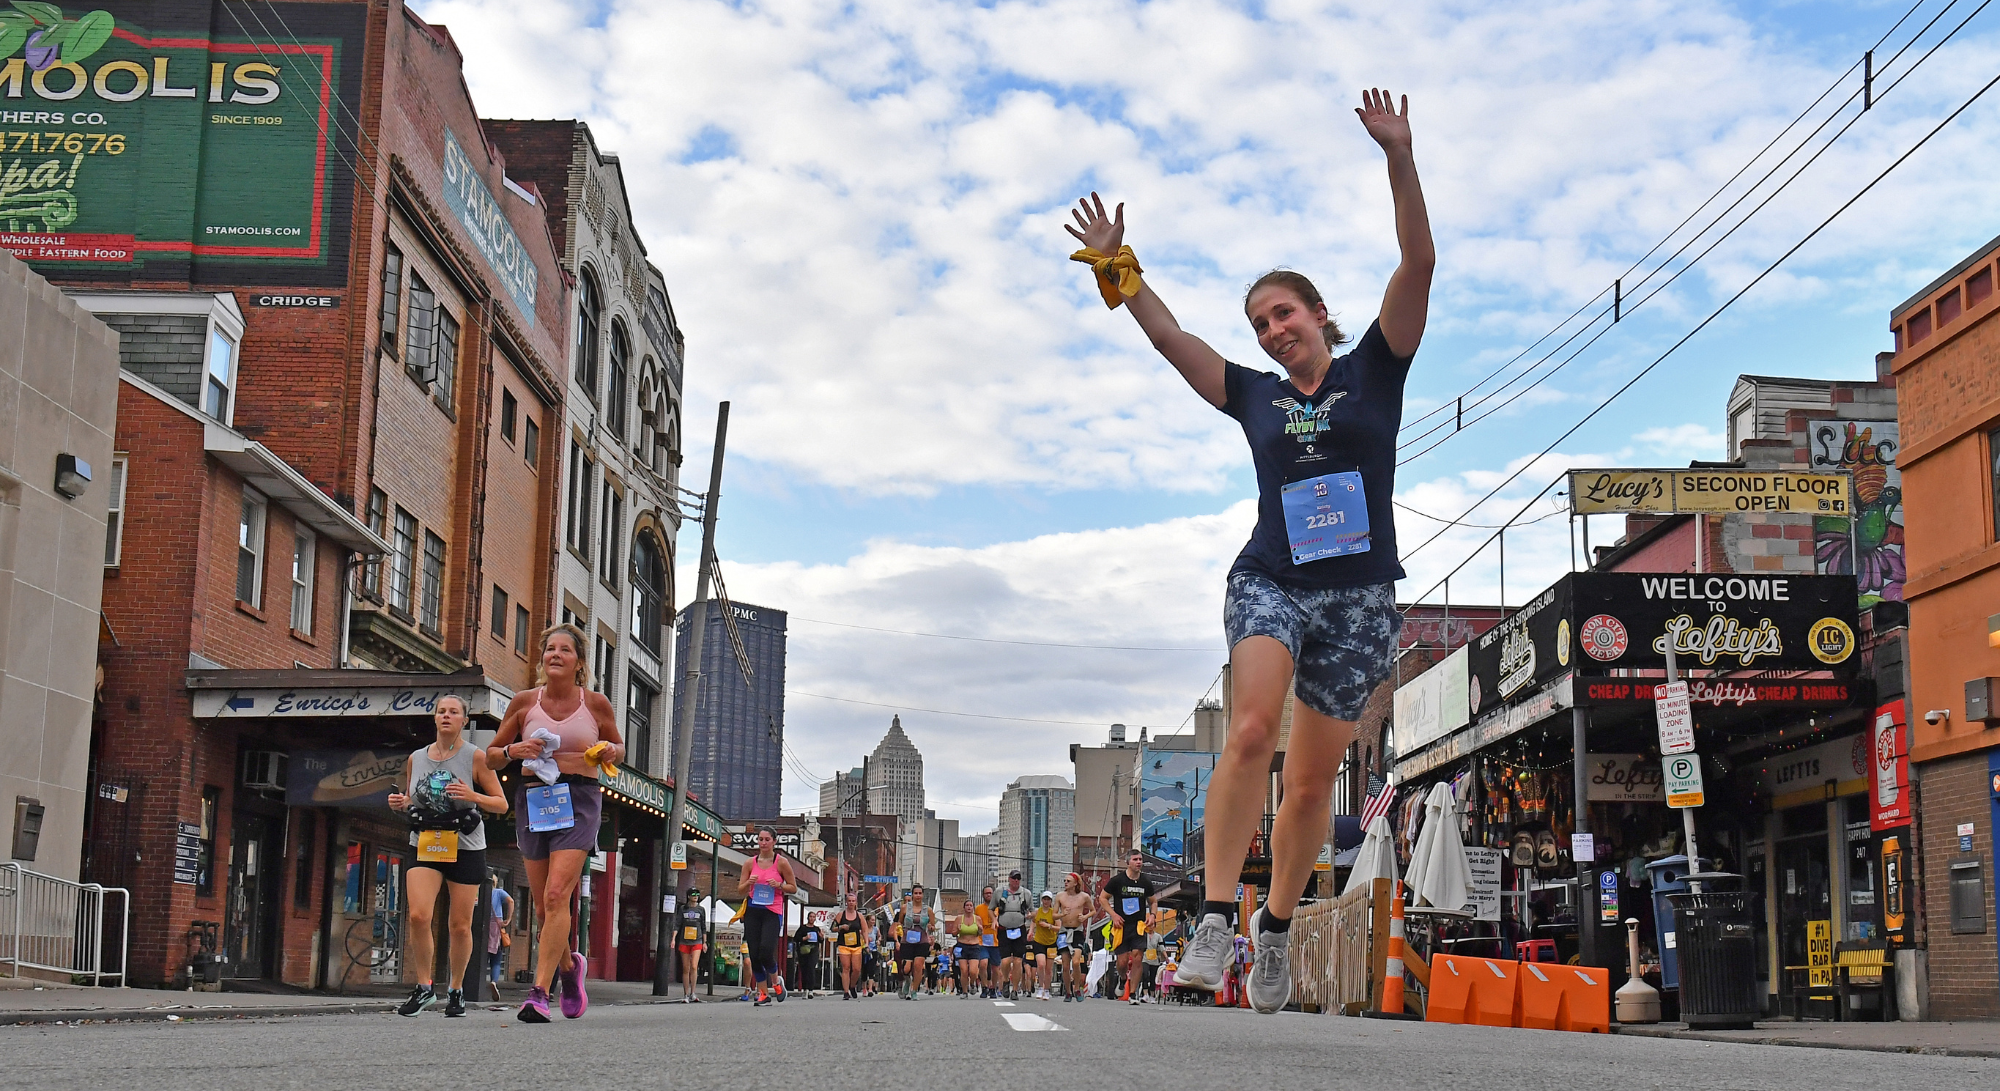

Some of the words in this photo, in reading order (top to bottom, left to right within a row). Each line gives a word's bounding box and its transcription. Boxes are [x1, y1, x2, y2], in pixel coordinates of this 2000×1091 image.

[0, 111, 65, 124] HERS
[71, 112, 108, 125] CO.
[211, 115, 251, 125] SINCE
[253, 116, 283, 126] 1909
[0, 153, 84, 206] pa!
[445, 139, 538, 305] STAMOOLIS
[205, 226, 301, 237] STAMOOLIS.COM
[258, 296, 332, 307] CRIDGE
[1581, 473, 1663, 506] Lucy's
[1682, 476, 1767, 492] SECOND
[1773, 477, 1840, 495] FLOOR
[1735, 495, 1790, 511] OPEN
[1306, 510, 1345, 530] 2281
[1300, 551, 1317, 560] Gear
[1317, 547, 1342, 556] Check
[1347, 543, 1363, 551] 2281
[1641, 577, 1790, 601] WELCOME
[730, 606, 758, 621] PMC
[1707, 600, 1727, 613] TO
[1480, 628, 1493, 650] HOME
[1500, 620, 1509, 637] THE
[1535, 588, 1555, 613] ISLAND
[1583, 617, 1603, 644] IRON
[1605, 618, 1625, 645] CITY
[1822, 629, 1839, 645] IC
[1652, 614, 1783, 666] Lefty's
[1588, 645, 1623, 659] BEER
[1588, 684, 1629, 699] CHEAP
[1656, 686, 1667, 698] NO
[1667, 684, 1686, 696] PARKING
[1688, 681, 1757, 706] Lefty's
[1756, 685, 1797, 700] CHEAP
[1802, 685, 1848, 700] DRINKS
[275, 692, 371, 714] Enrico's
[392, 690, 452, 715] Caf
[1658, 702, 1666, 711] 30
[1667, 699, 1688, 709] MINUTE
[1659, 708, 1688, 720] LOADING
[1666, 718, 1684, 728] ZONE
[1661, 730, 1666, 738] 8
[304, 757, 328, 771] The
[1676, 762, 1688, 776] P
[1777, 759, 1820, 784] LEFTYS
[1668, 780, 1677, 788] PAY
[1678, 779, 1700, 788] PARKING
[539, 805, 561, 816] 3105
[683, 802, 699, 825] ROS.
[1847, 828, 1862, 842] HAPPY
[426, 845, 448, 853] 5094
[1480, 850, 1500, 858] Lefty's
[1856, 846, 1866, 859] 24/7
[1814, 923, 1825, 938] #1
[1810, 939, 1829, 953] DIVE
[1812, 954, 1829, 966] BAR
[1811, 970, 1819, 984] in
[1821, 970, 1830, 984] PA
